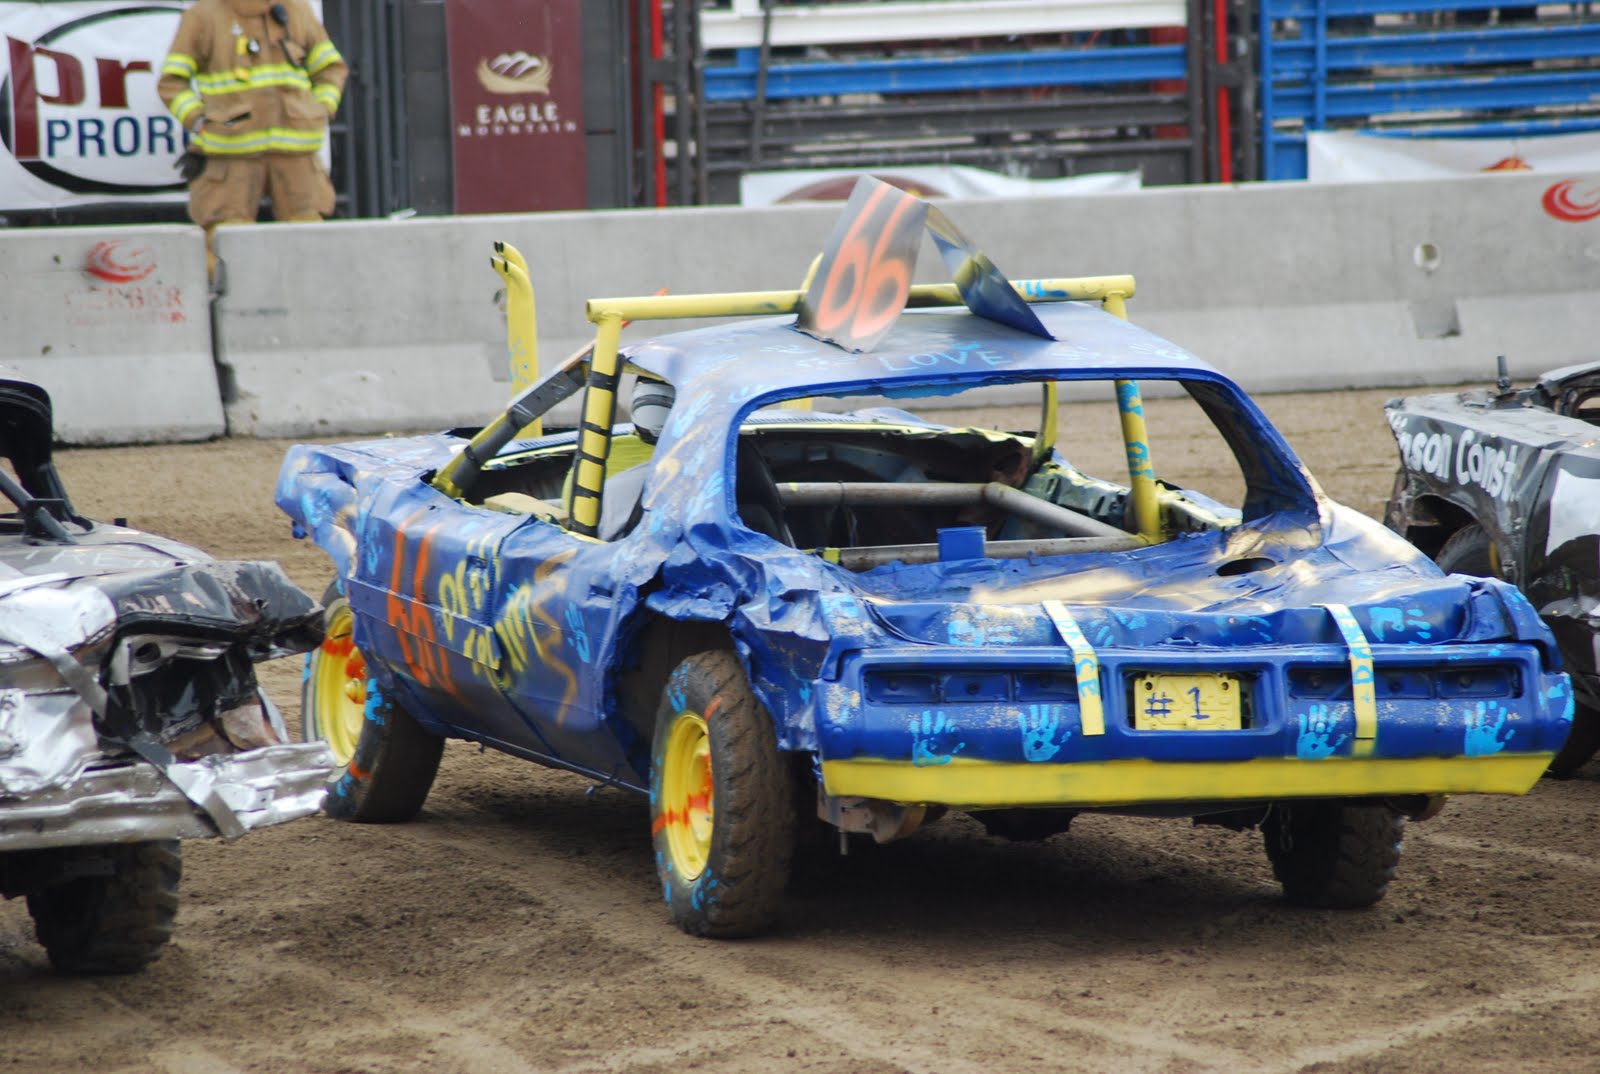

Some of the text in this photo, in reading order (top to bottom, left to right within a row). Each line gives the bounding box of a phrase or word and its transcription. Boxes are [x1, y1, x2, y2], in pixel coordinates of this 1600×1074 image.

[458, 120, 577, 136] MOUNTAIN
[477, 101, 558, 124] EAGLE
[46, 115, 192, 158] PROR
[817, 182, 916, 339] 66
[879, 348, 1012, 371] LOVE
[1456, 429, 1519, 502] Const
[1187, 686, 1210, 720] 1
